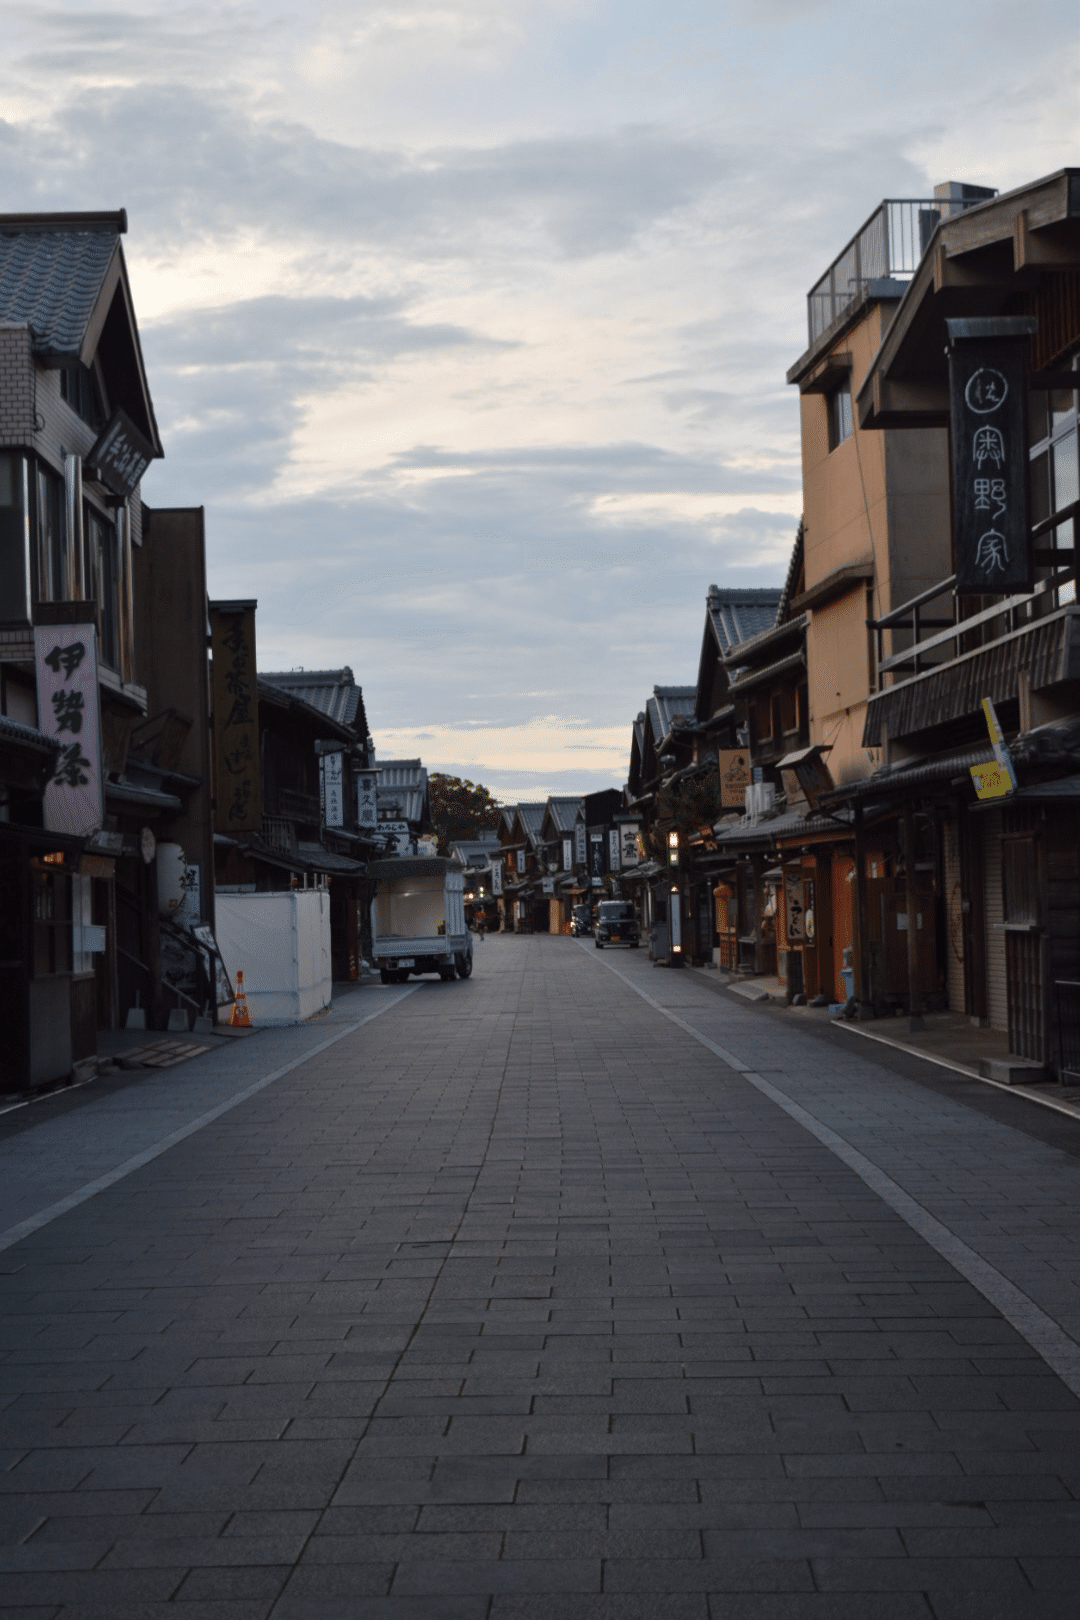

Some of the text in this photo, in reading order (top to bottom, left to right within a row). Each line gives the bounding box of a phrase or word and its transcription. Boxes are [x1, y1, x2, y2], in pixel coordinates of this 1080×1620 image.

[46, 642, 90, 786] 伊勢茶
[377, 824, 406, 832] わらじや
